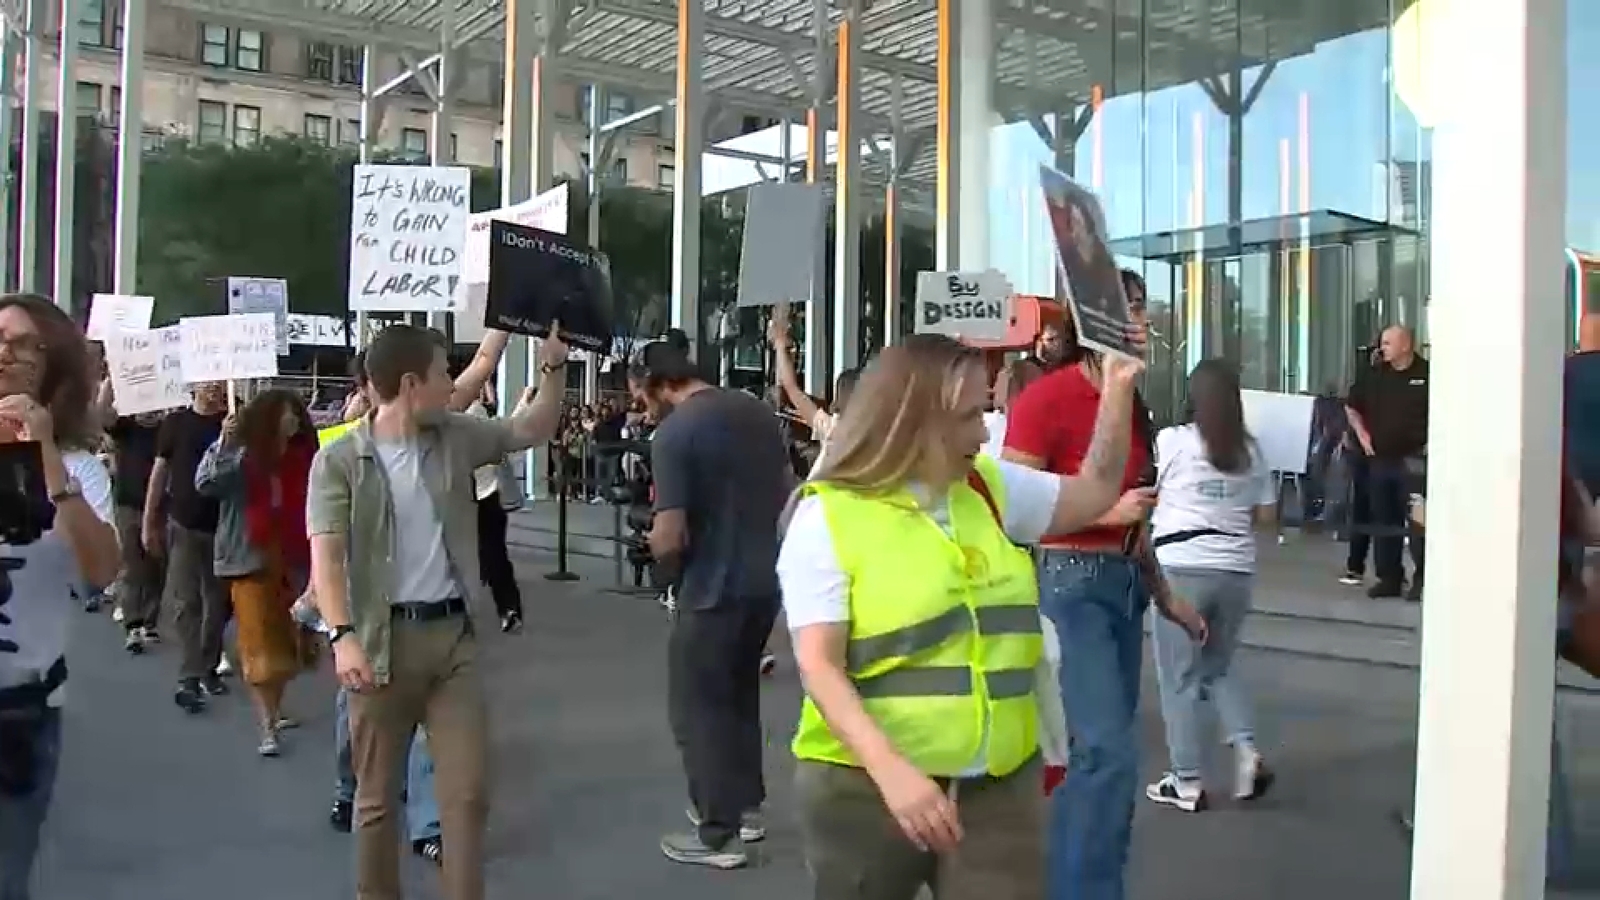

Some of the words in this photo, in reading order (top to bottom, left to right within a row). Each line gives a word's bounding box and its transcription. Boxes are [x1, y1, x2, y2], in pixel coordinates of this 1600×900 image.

[408, 176, 466, 208] WRONG
[362, 203, 379, 228] to
[392, 207, 450, 233] GAIN
[389, 239, 457, 265] CHILD
[923, 301, 1002, 325] DESIGN
